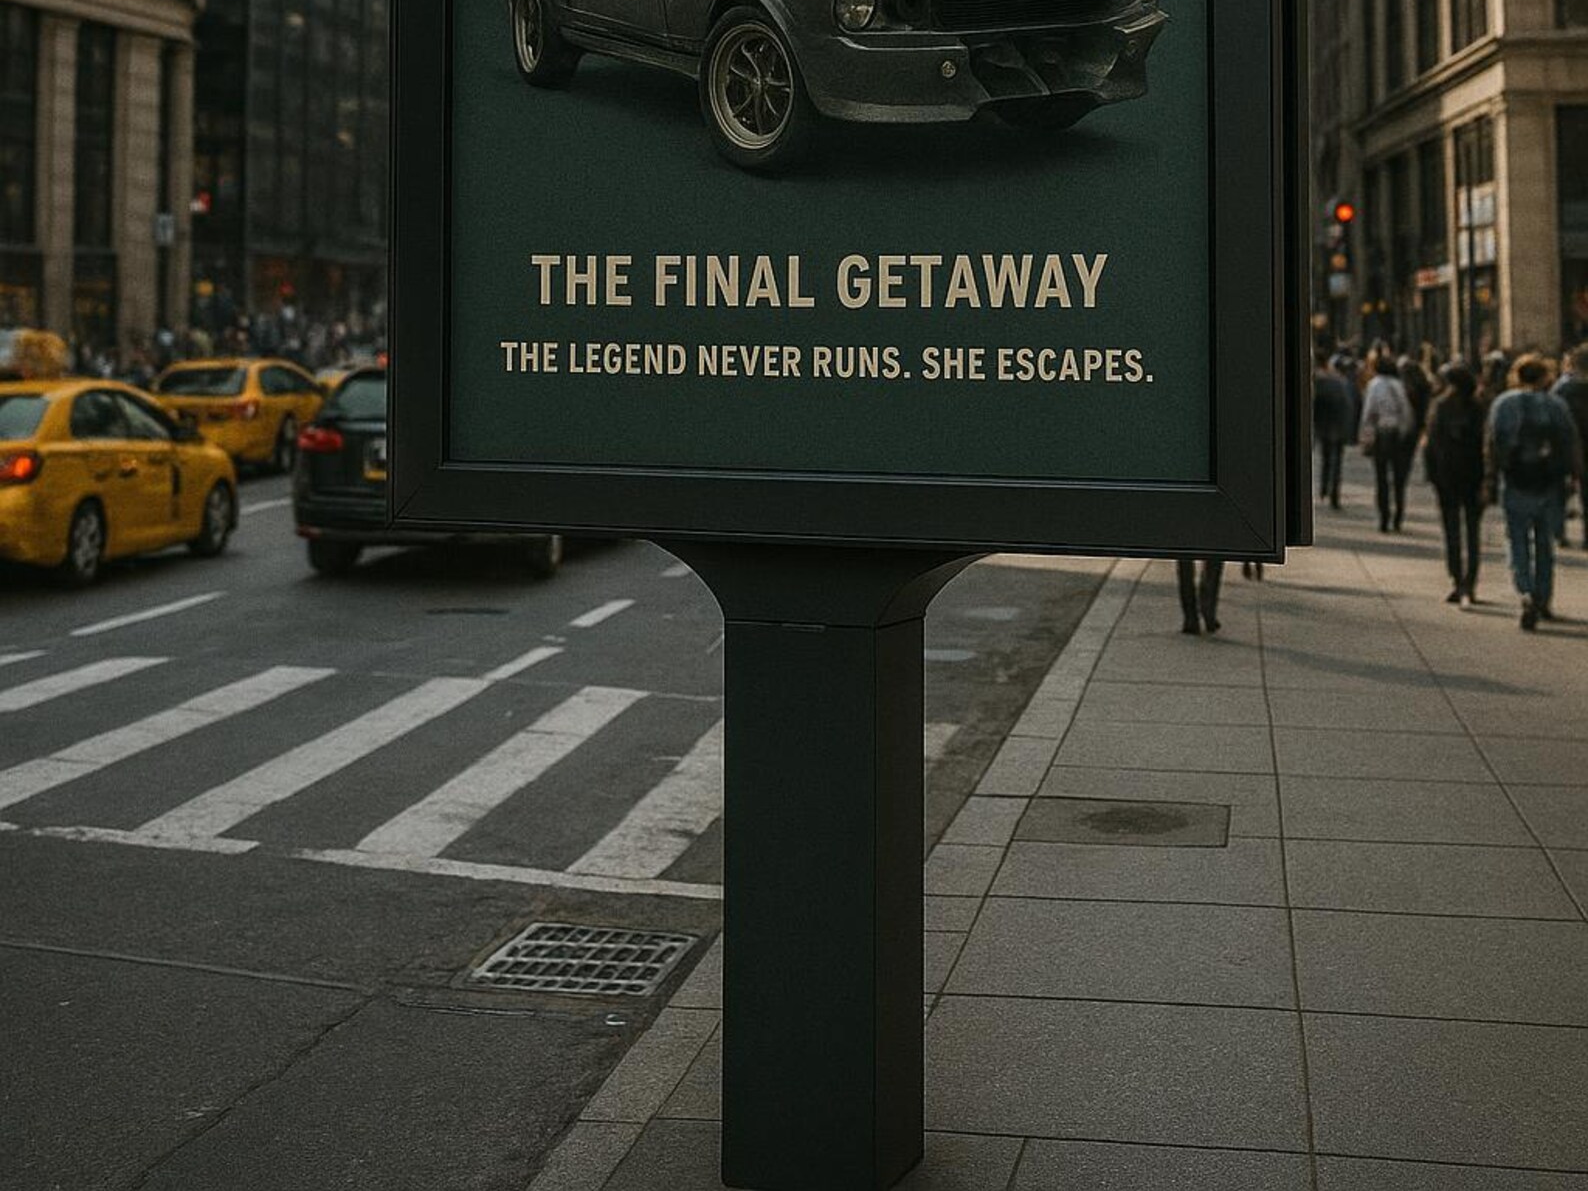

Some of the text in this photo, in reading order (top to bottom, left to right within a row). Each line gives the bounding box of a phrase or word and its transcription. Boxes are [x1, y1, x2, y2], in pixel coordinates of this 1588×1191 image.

[531, 253, 1108, 309] THE FINAL GETAWAY
[500, 341, 1155, 383] THE LEGEND NEVER RUNS. SHE ESCAPES.
